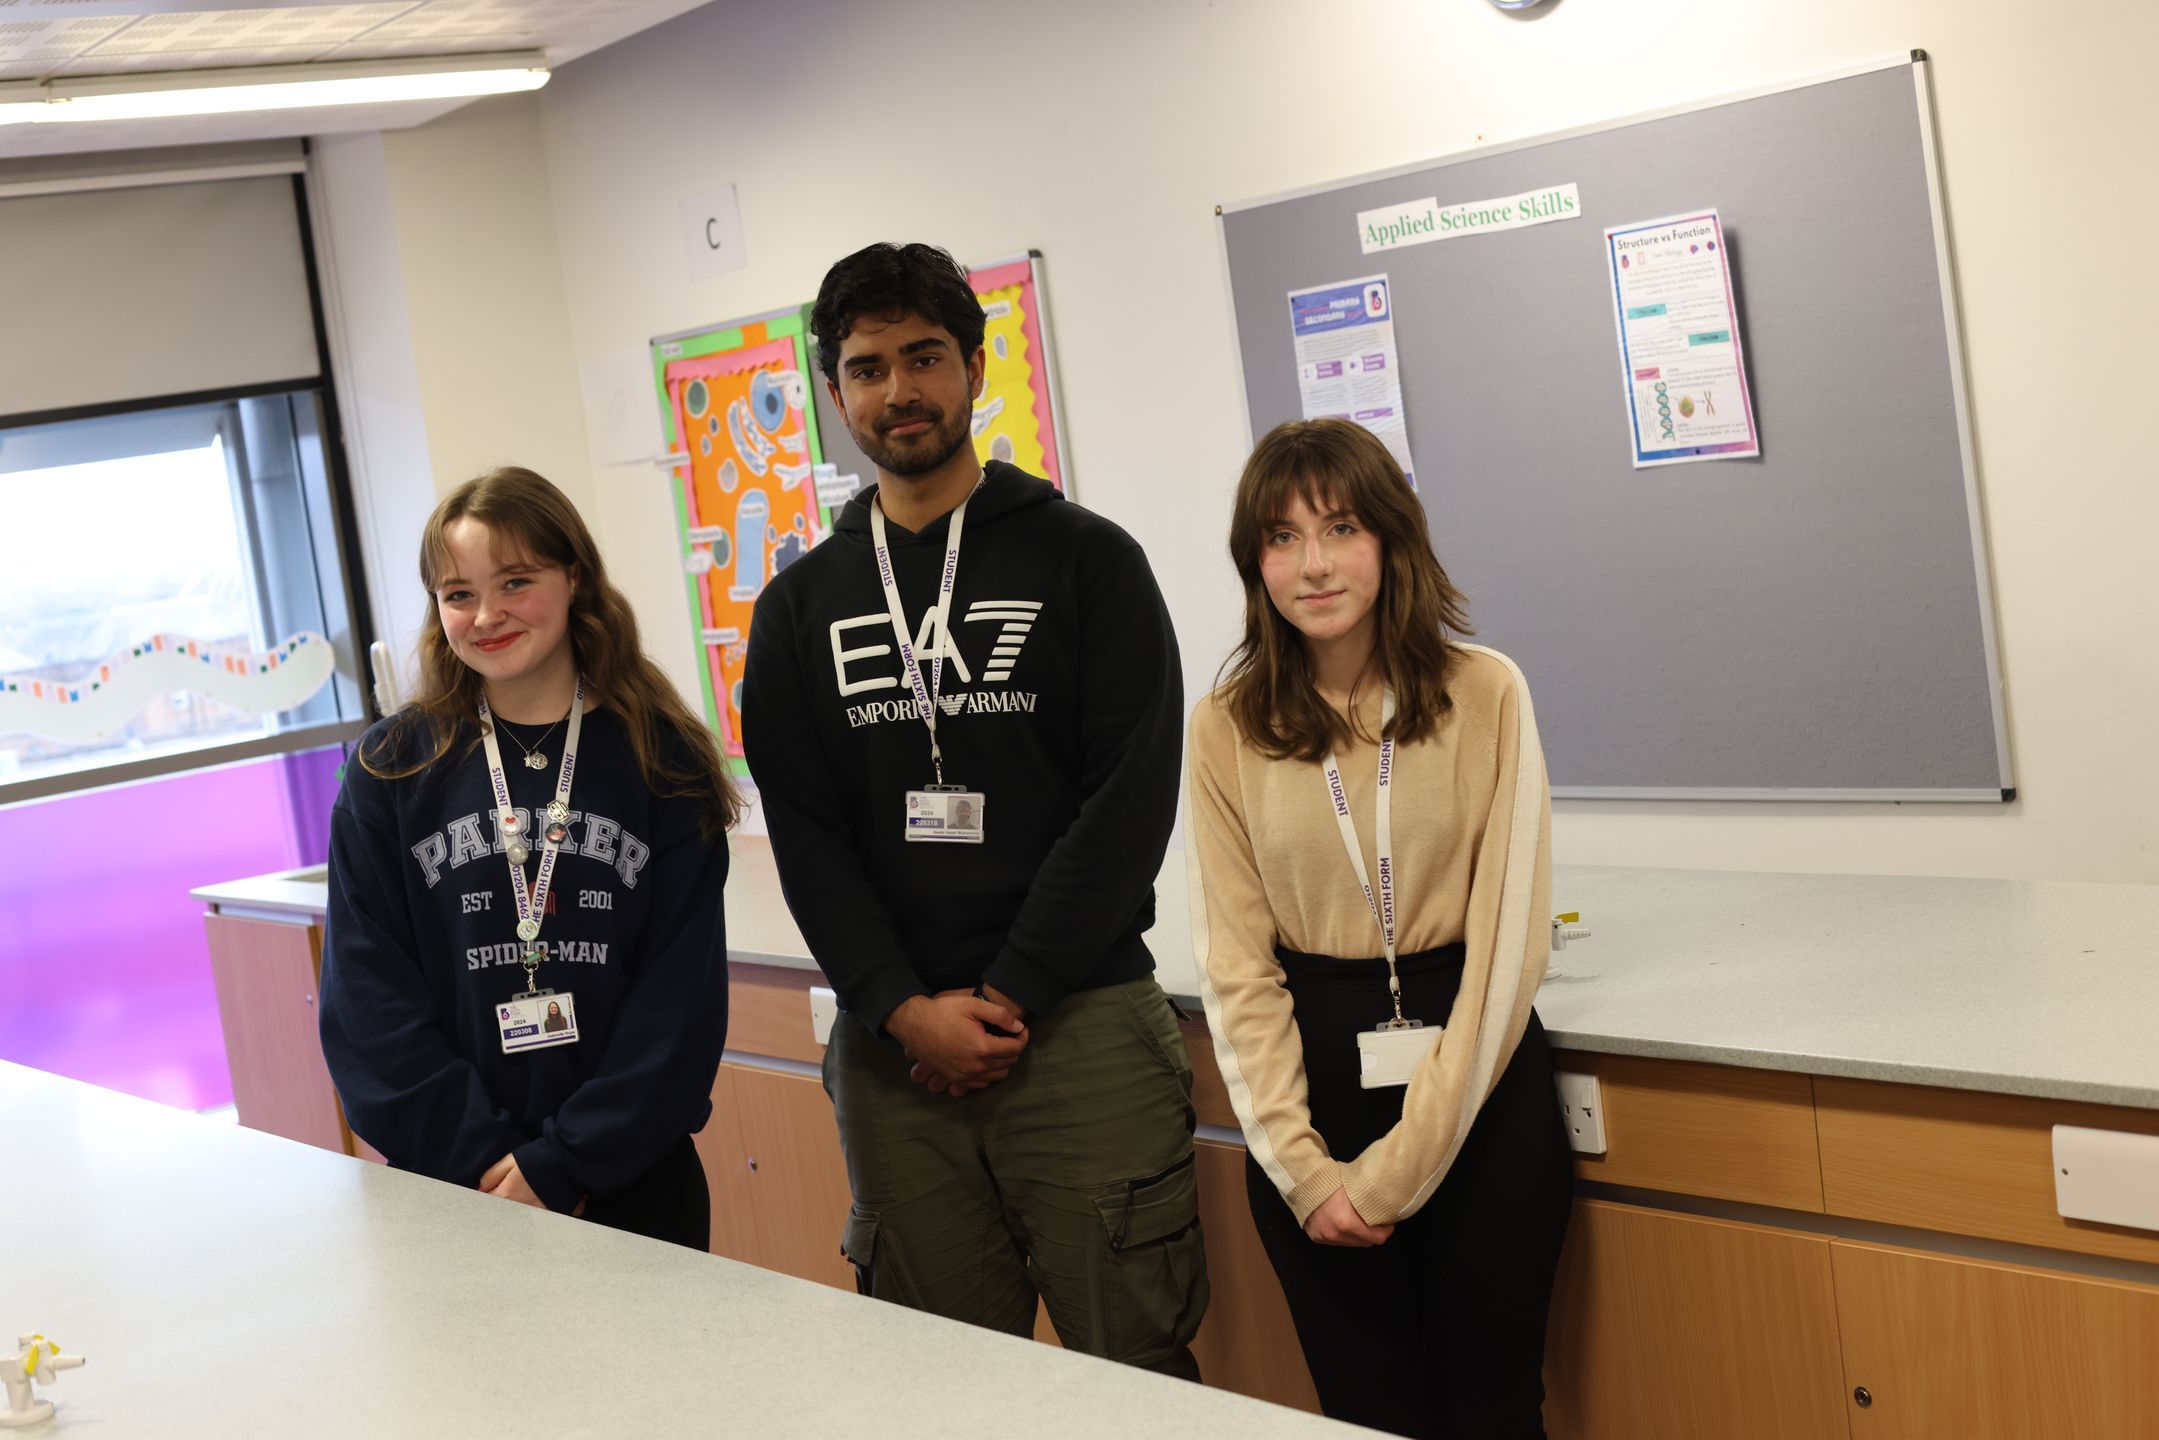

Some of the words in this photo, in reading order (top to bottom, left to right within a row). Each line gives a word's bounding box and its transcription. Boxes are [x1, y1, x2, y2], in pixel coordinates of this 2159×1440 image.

[705, 217, 721, 250] C
[1365, 210, 1435, 246] Applied
[1440, 207, 1513, 231] Science
[1518, 191, 1575, 221] Skills
[1618, 237, 1659, 251] Structure
[1661, 234, 1671, 242] vs
[1672, 225, 1711, 241] Function
[877, 546, 893, 587] STUDENT
[943, 549, 957, 593] STUDENT
[829, 600, 1044, 698] EA7
[901, 643, 918, 673] FORM
[911, 673, 927, 702] SIXTH
[933, 657, 941, 686] 01204
[846, 699, 924, 728] EMPORI
[966, 691, 1038, 714] ARMANI
[921, 702, 932, 721] THE
[560, 753, 575, 793] STUDENT
[1379, 737, 1392, 786] STUDENT
[491, 767, 508, 806] STUDENT
[1328, 769, 1349, 816] STUDENT
[410, 807, 651, 890] PARKER
[541, 849, 555, 878] FORM
[512, 863, 524, 896] 01204
[1380, 857, 1392, 890] FORM
[461, 891, 493, 914] EST
[535, 880, 548, 908] SIXTH
[579, 889, 613, 911] 2001
[1382, 893, 1394, 924] SIXTH
[532, 910, 542, 925] HE
[1386, 927, 1394, 945] THE
[466, 940, 609, 971] SPIDR-MAN
